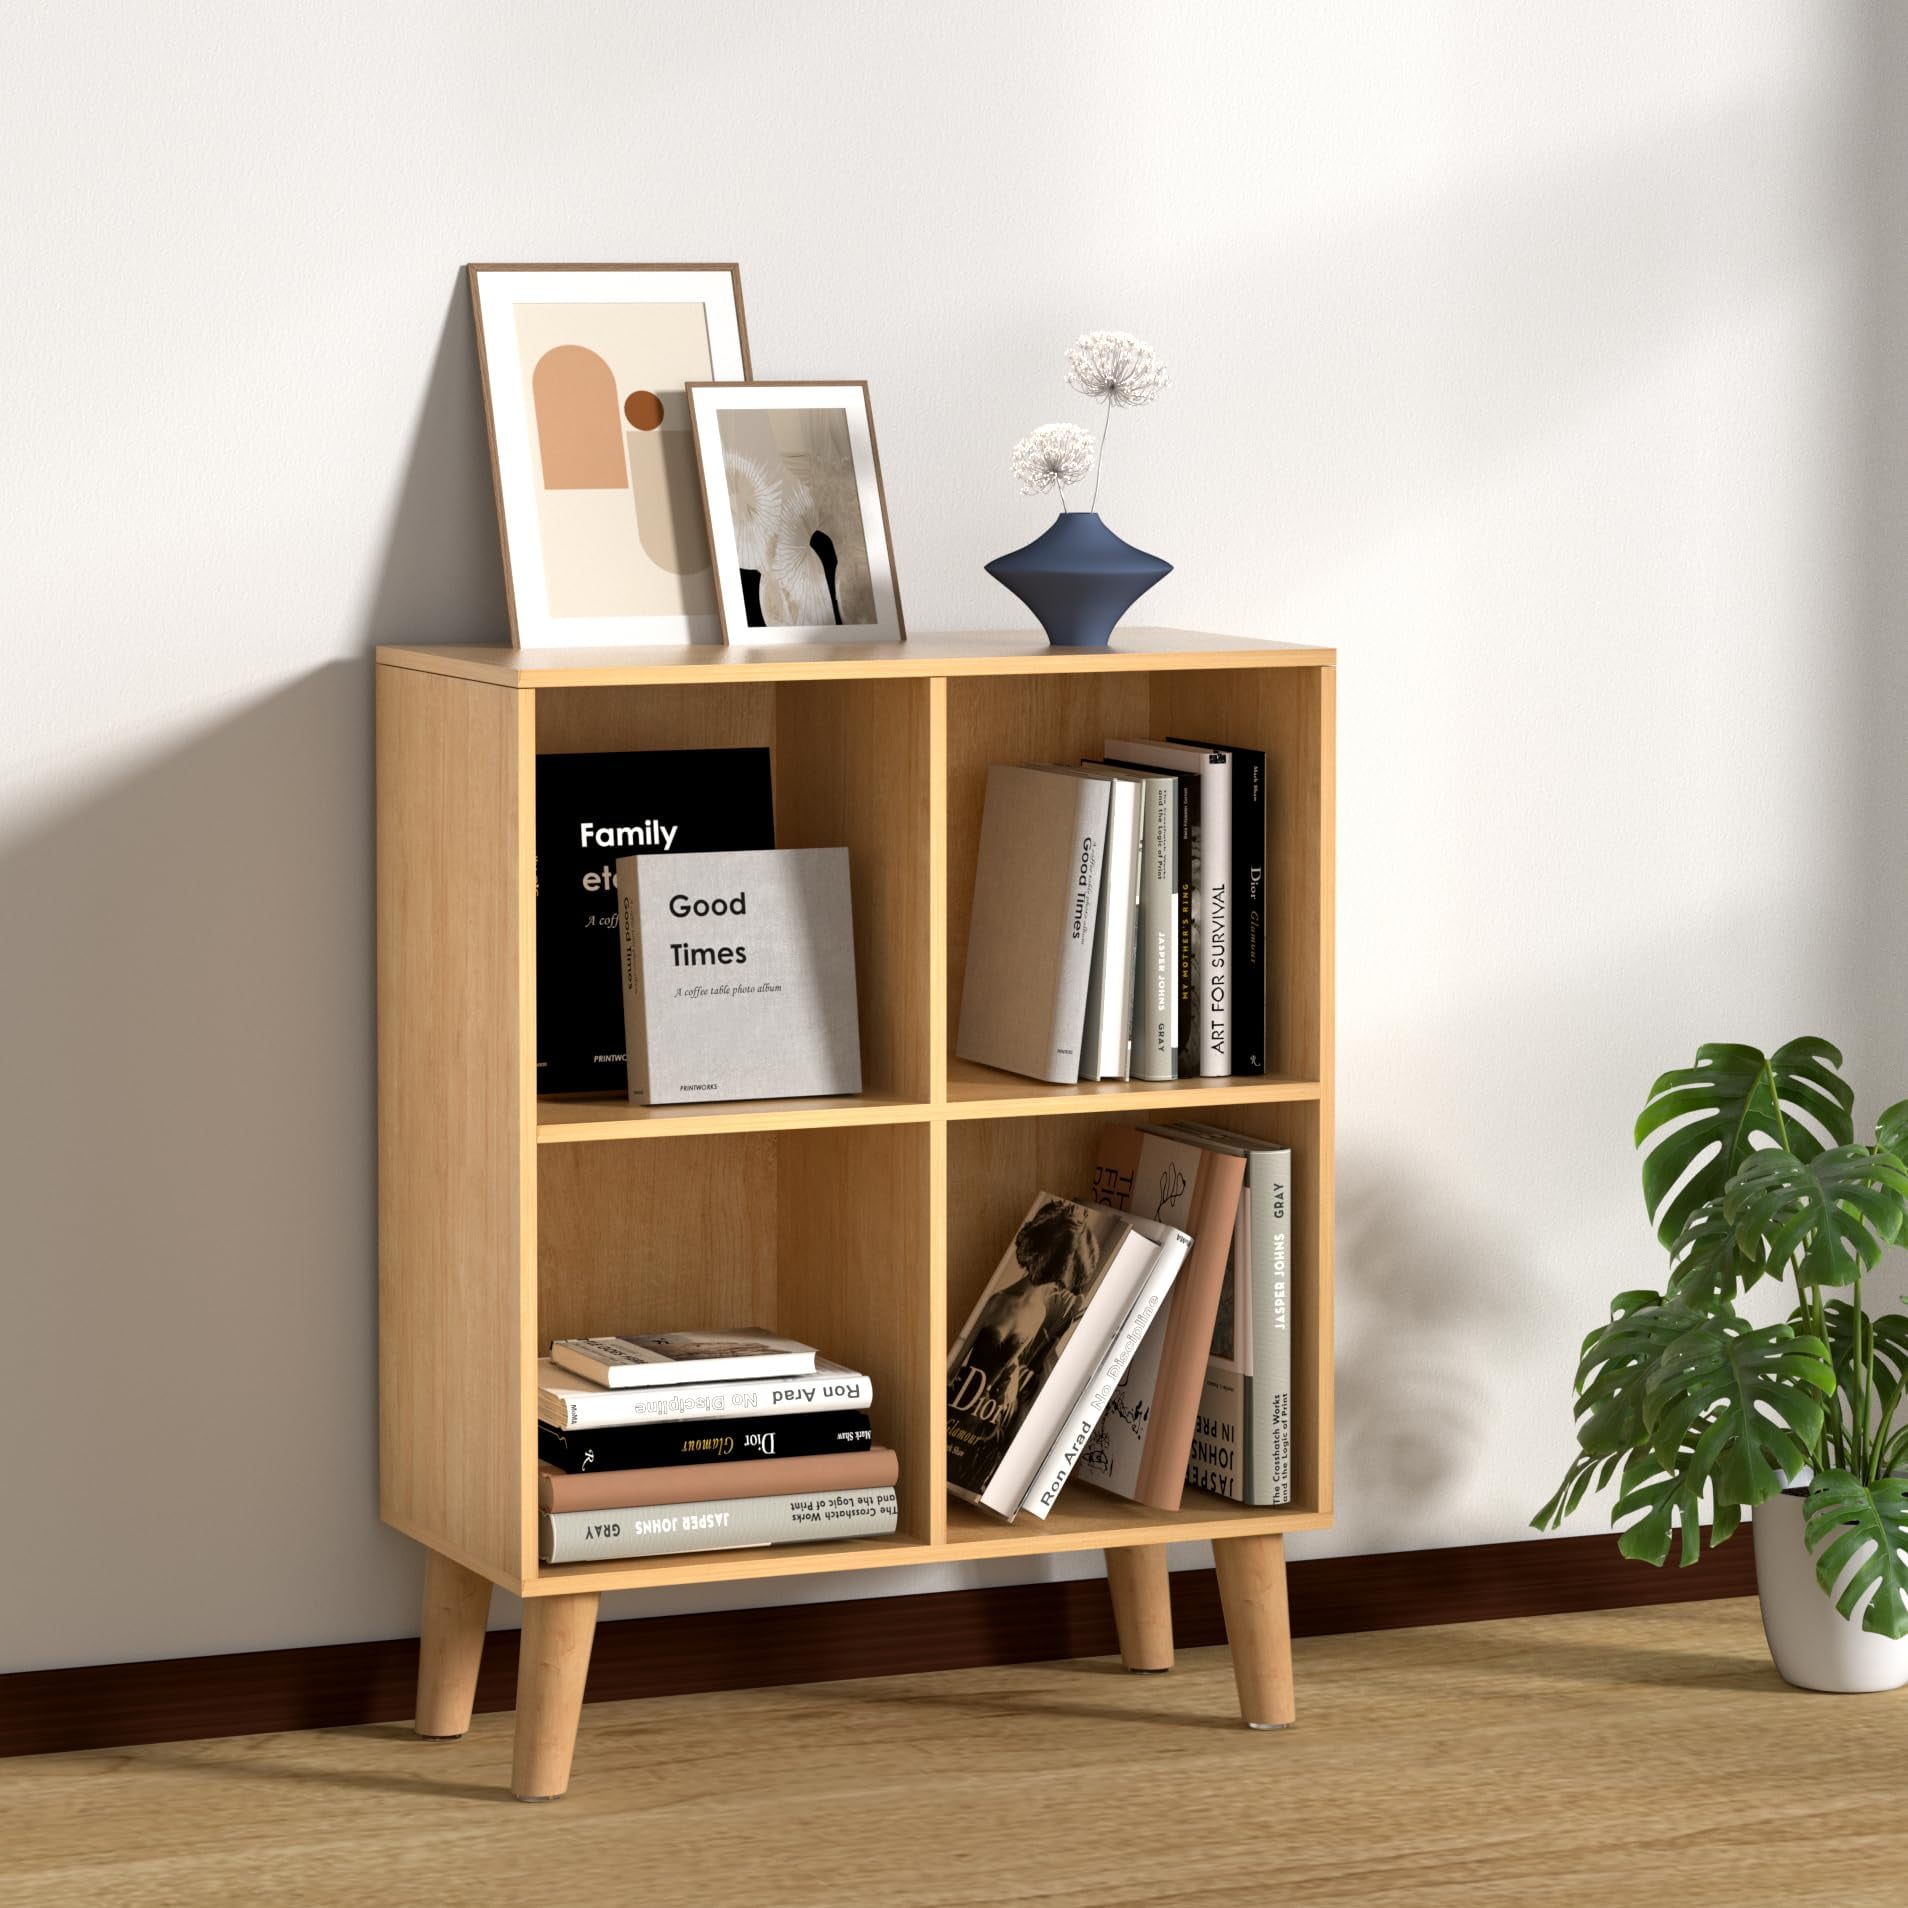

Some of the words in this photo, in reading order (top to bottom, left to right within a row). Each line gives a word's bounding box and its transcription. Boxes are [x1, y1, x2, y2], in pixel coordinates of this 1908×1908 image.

[580, 820, 678, 850] Family
[1078, 838, 1092, 886] Good
[1158, 850, 1163, 858] of
[1250, 866, 1262, 900] Dior
[670, 892, 746, 918] Good
[585, 915, 596, 928] A
[1072, 893, 1086, 939] Times
[1211, 884, 1225, 968] SURVIVAL
[1250, 911, 1260, 964] Glamour
[670, 943, 747, 966] Times
[1158, 932, 1166, 972] JASPER
[674, 988, 682, 998] A
[684, 986, 708, 998] coffee
[710, 984, 730, 996] table
[732, 984, 755, 997] photo
[757, 982, 782, 993] album
[1158, 979, 1166, 1011] JOHNS
[1182, 984, 1188, 1000] MY
[1211, 974, 1224, 1012] FOR
[1211, 1020, 1225, 1054] ART
[680, 1084, 718, 1092] PRINTWORKS
[1274, 1184, 1284, 1218] GRAY
[1274, 1234, 1285, 1276] JOHNS
[1274, 1282, 1285, 1330] JASPER
[732, 1392, 758, 1408] No
[772, 1388, 816, 1404] Arad
[823, 1384, 860, 1399] Ron
[948, 1366, 1004, 1424] Dior
[1040, 1470, 1066, 1507] Ron
[1064, 1421, 1092, 1466] Arad
[1090, 1382, 1112, 1412] No
[1107, 1294, 1158, 1380] Discipline
[570, 1404, 578, 1424] MoMA
[634, 1396, 725, 1416] Discipline
[1272, 1394, 1280, 1424] Works
[1222, 1422, 1234, 1444] IN
[1281, 1420, 1288, 1430] of
[744, 1432, 776, 1454] Dior
[836, 1431, 854, 1442] Shaw
[854, 1430, 872, 1441] Mark
[681, 1436, 734, 1456] Glamour
[1191, 1438, 1234, 1471] JOHNS
[1272, 1428, 1280, 1482] Crosshatch
[1281, 1432, 1290, 1462] Logic
[816, 1500, 826, 1508] of
[828, 1496, 854, 1508] Logic
[858, 1496, 874, 1507] the
[877, 1494, 896, 1506] and
[1272, 1486, 1280, 1504] The
[790, 1502, 813, 1512] Print
[825, 1508, 876, 1520] Crosshatch
[880, 1506, 898, 1516] The
[635, 1517, 678, 1535] JOHNS
[682, 1513, 730, 1530] JASPER
[792, 1514, 821, 1524] Works
[585, 1523, 620, 1540] GRAY
